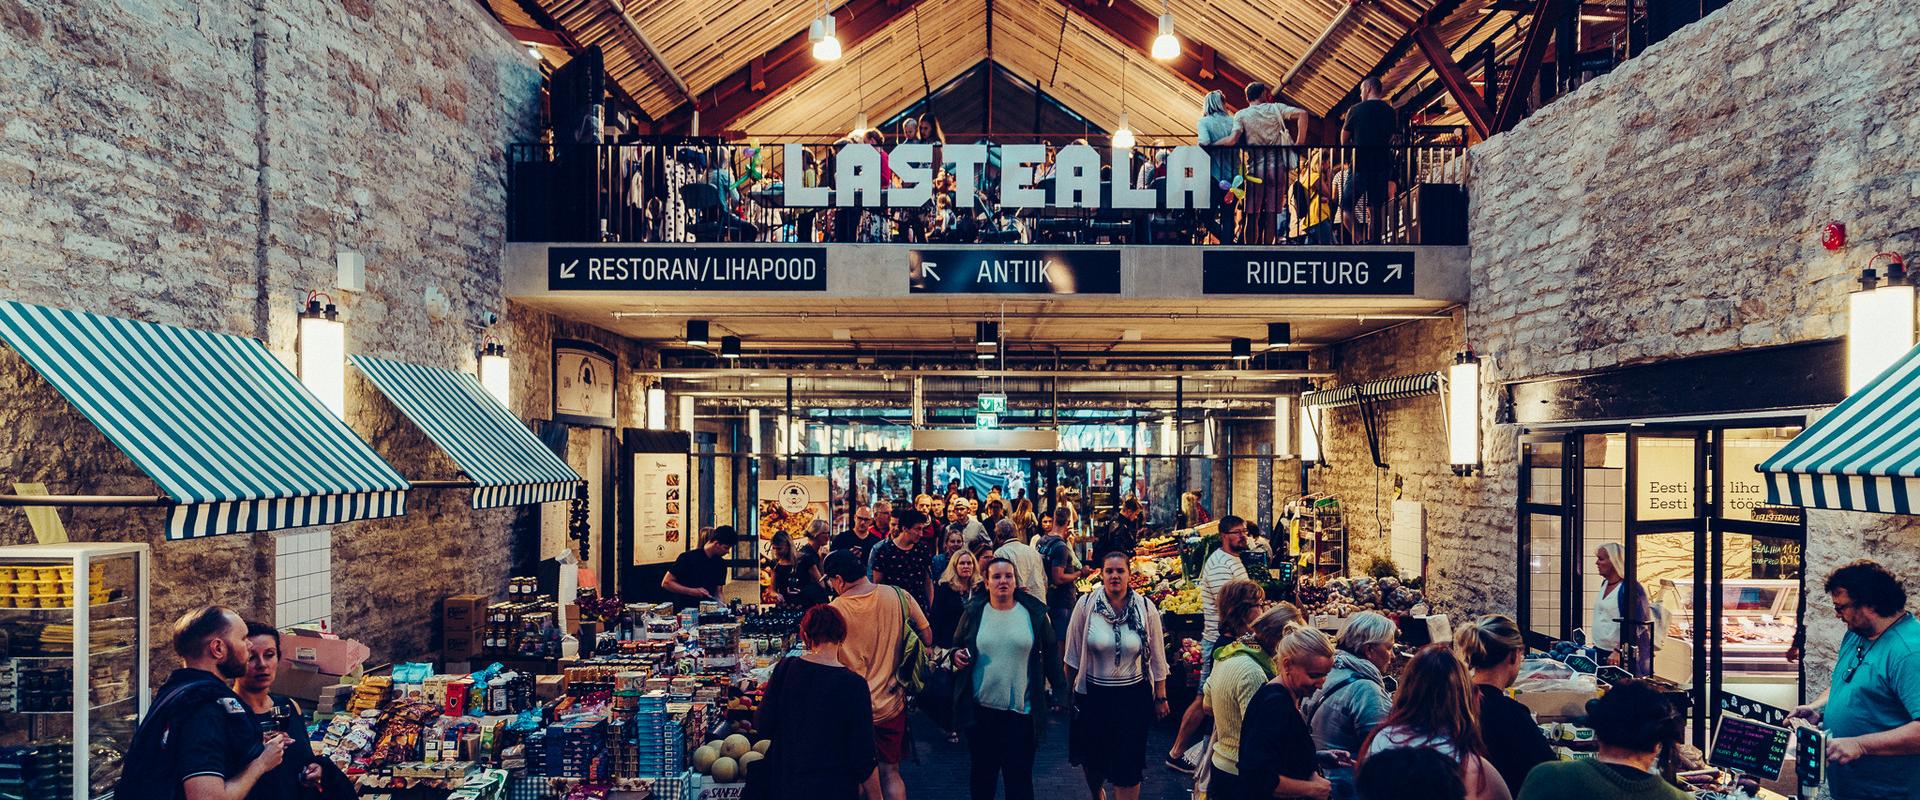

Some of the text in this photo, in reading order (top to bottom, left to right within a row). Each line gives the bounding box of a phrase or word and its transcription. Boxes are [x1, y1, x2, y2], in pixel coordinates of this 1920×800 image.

[784, 143, 1211, 209] LASTEALA
[588, 256, 816, 283] RESTORAN/LIHAPOOD
[976, 259, 1053, 284] ANTIIK
[1247, 260, 1370, 285] RIIDETURG
[1649, 481, 1688, 494] Eesti
[1730, 481, 1760, 494] liha
[1649, 497, 1688, 510] Eesti
